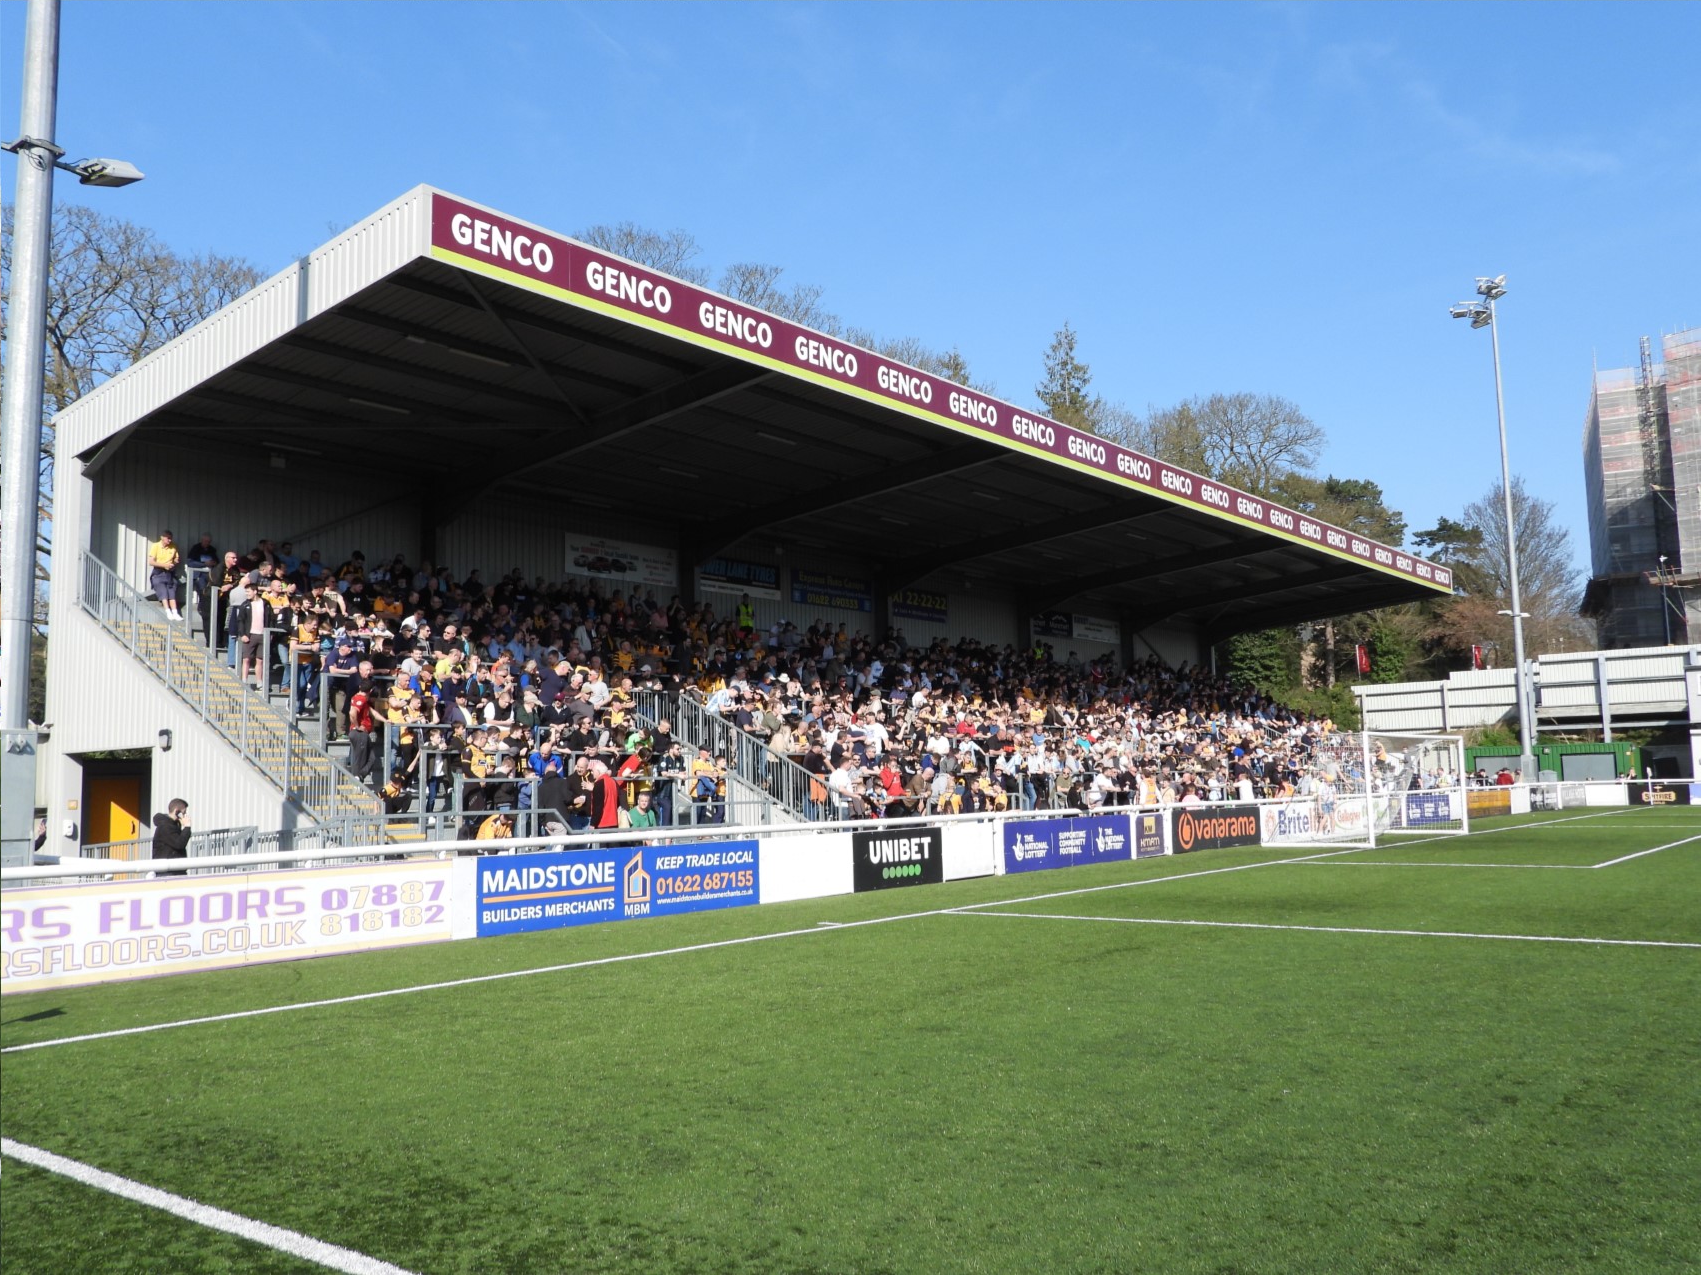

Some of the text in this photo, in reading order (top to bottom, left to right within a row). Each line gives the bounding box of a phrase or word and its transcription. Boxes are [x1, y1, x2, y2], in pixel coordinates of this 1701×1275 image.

[451, 213, 1449, 584] GENCO GENCO GENCO GENCO GENCO GENCO GENCO GENCO GENCO GENCO GENCO GENCO GENCO GENCO GENCO GENCO GENCO GENCO GENCO GENCO
[1104, 827, 1113, 835] THE
[1194, 815, 1256, 840] vanarama
[1024, 834, 1034, 842] THE
[1058, 830, 1087, 839] SUPPORTING
[1104, 834, 1125, 843] NATIONAL
[1024, 841, 1049, 850] NATIONAL
[1058, 838, 1086, 848] COMMUNITY
[1105, 841, 1124, 850] LOTTERY
[868, 836, 932, 865] UNIBET
[1024, 849, 1048, 859] LOTTERY
[1059, 846, 1082, 855] FOOTBALL
[482, 849, 754, 894] MAIDSTONE KEEP TRADE LOCAL
[656, 870, 754, 895] 01622 687155
[98, 885, 306, 935] FLOORS
[320, 880, 446, 911] 07887
[482, 897, 650, 924] BUILDERS MERCHANTS MBM
[319, 905, 446, 936] 818182
